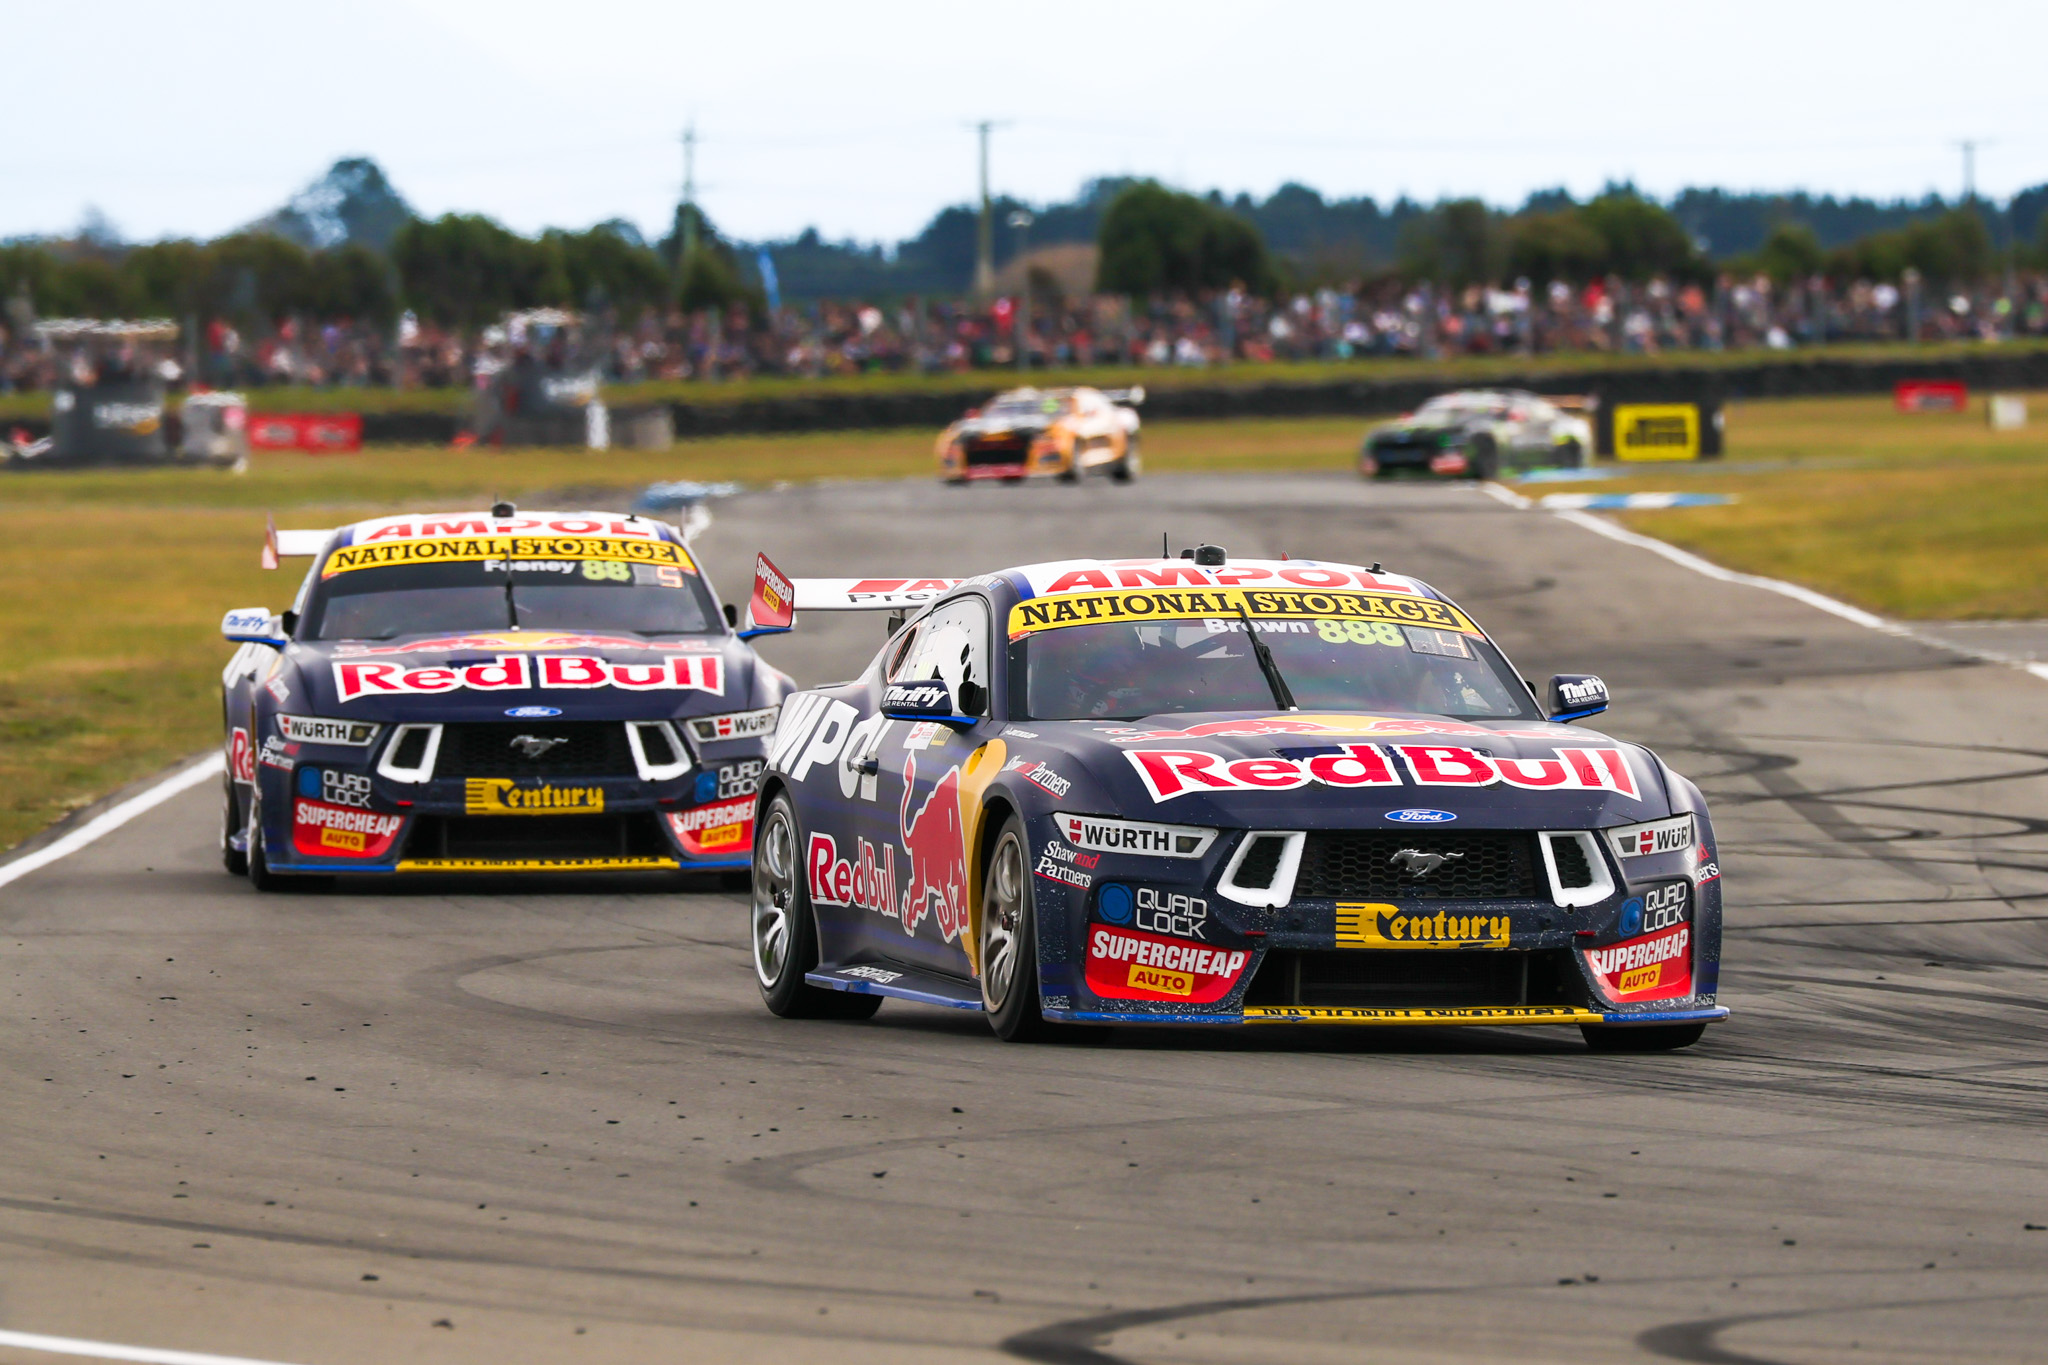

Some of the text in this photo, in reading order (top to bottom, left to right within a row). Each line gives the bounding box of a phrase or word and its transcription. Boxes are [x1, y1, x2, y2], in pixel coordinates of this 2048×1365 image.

[364, 519, 650, 541] AMPOL
[335, 538, 677, 569] NATIONAL STORAGE
[580, 560, 631, 582] 88
[756, 556, 793, 606] SUPERCHEAP
[1045, 567, 1412, 593] AMPOL
[764, 589, 778, 608] AUTO
[1018, 592, 1454, 627] NATIONAL STORAGE
[1203, 619, 1406, 648] Brown 888
[332, 655, 532, 702] Red
[536, 653, 726, 696] Bull
[883, 686, 949, 707] Thrifty
[1581, 694, 1602, 703] RENTAL
[290, 721, 347, 740] WÜRTH
[323, 769, 371, 793] QUAD
[719, 760, 762, 784] QUAD
[1025, 761, 1072, 797] Partners
[1122, 742, 1642, 804] Red Bull
[323, 787, 372, 809] LOCK
[466, 778, 604, 815] Century
[297, 803, 400, 837] SUPERCHEAP
[1402, 811, 1440, 820] Ford
[326, 833, 360, 847] AUTO
[1085, 824, 1169, 850] WÜRTH
[807, 831, 899, 918] Red Bull
[1035, 856, 1091, 887] Partners
[1136, 888, 1207, 918] QUAD
[1646, 882, 1686, 911] QUAD
[1136, 912, 1206, 939] LOCK
[1335, 902, 1510, 949] Century
[1644, 902, 1684, 932] LOCK
[1092, 930, 1245, 978] SUPERCHEAP
[1591, 929, 1688, 977] SUPERCHEAP
[1134, 970, 1185, 989] AUTO
[1623, 971, 1657, 988] AUTO
